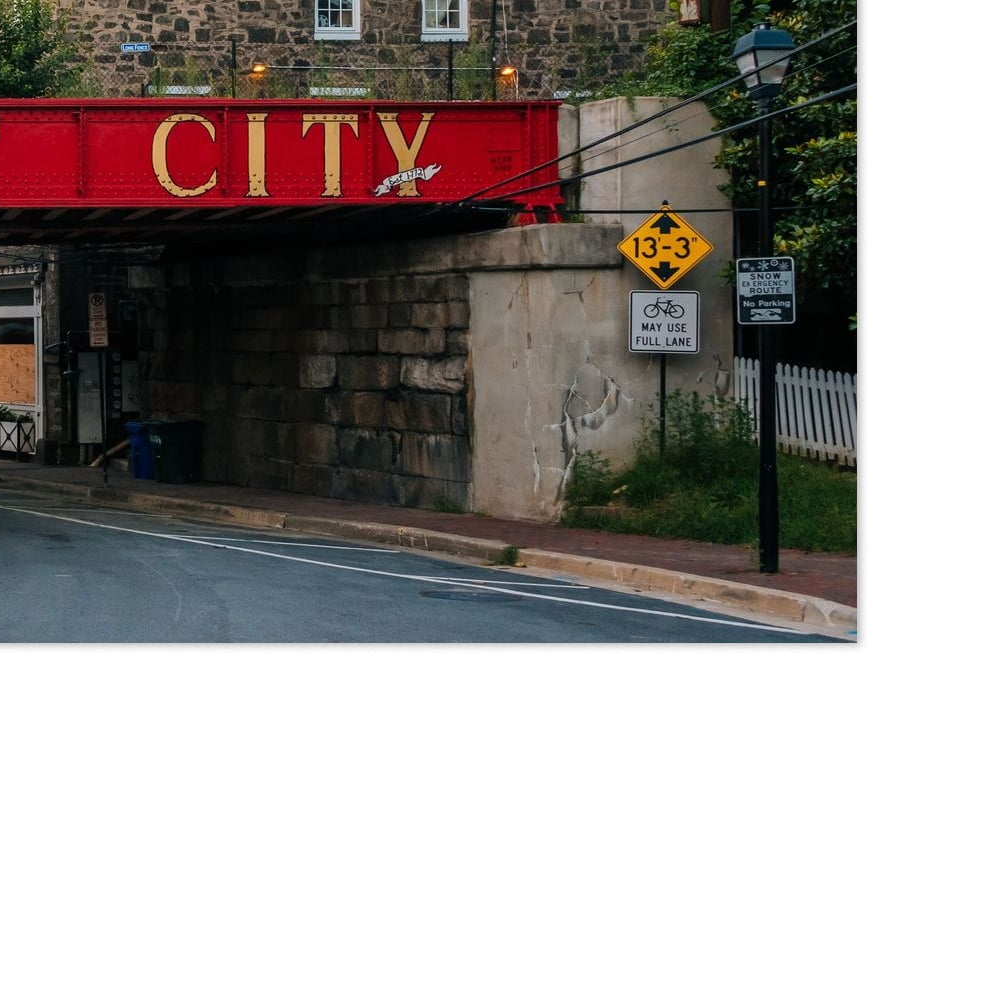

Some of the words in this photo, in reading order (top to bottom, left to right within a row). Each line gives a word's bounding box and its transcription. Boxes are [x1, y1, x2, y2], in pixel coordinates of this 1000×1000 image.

[151, 112, 436, 197] CITY
[750, 272, 781, 280] SNOW
[743, 300, 756, 308] No
[758, 300, 791, 308] Parking
[641, 322, 662, 332] MAY
[667, 323, 687, 333] USE
[635, 336, 660, 346] FULL
[665, 337, 692, 347] LANE
